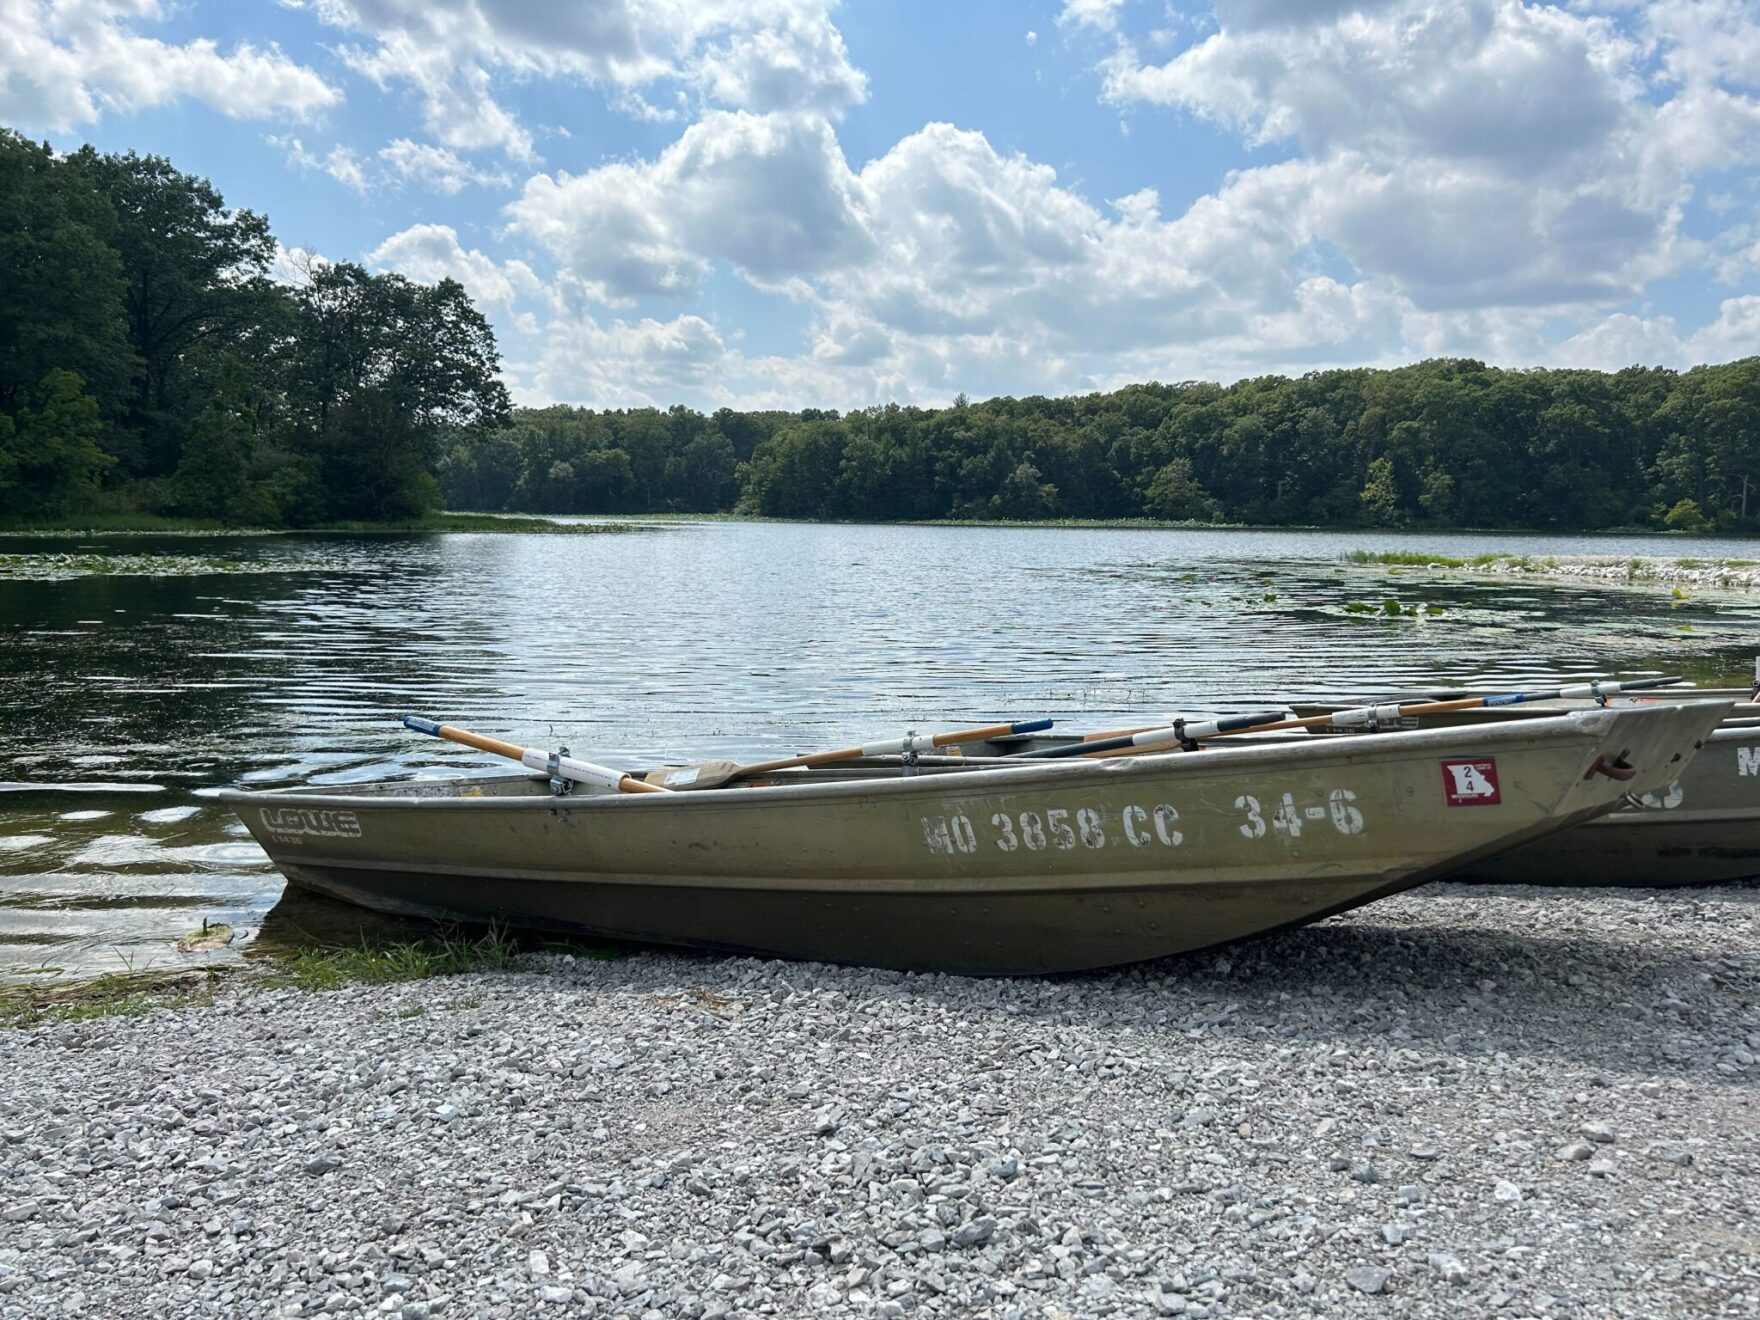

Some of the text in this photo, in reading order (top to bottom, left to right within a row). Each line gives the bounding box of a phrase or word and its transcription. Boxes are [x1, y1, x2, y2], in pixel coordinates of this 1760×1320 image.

[1463, 766, 1472, 778] 2
[1466, 780, 1474, 792] 4
[920, 788, 1364, 853] MO 3858 CC 34-6
